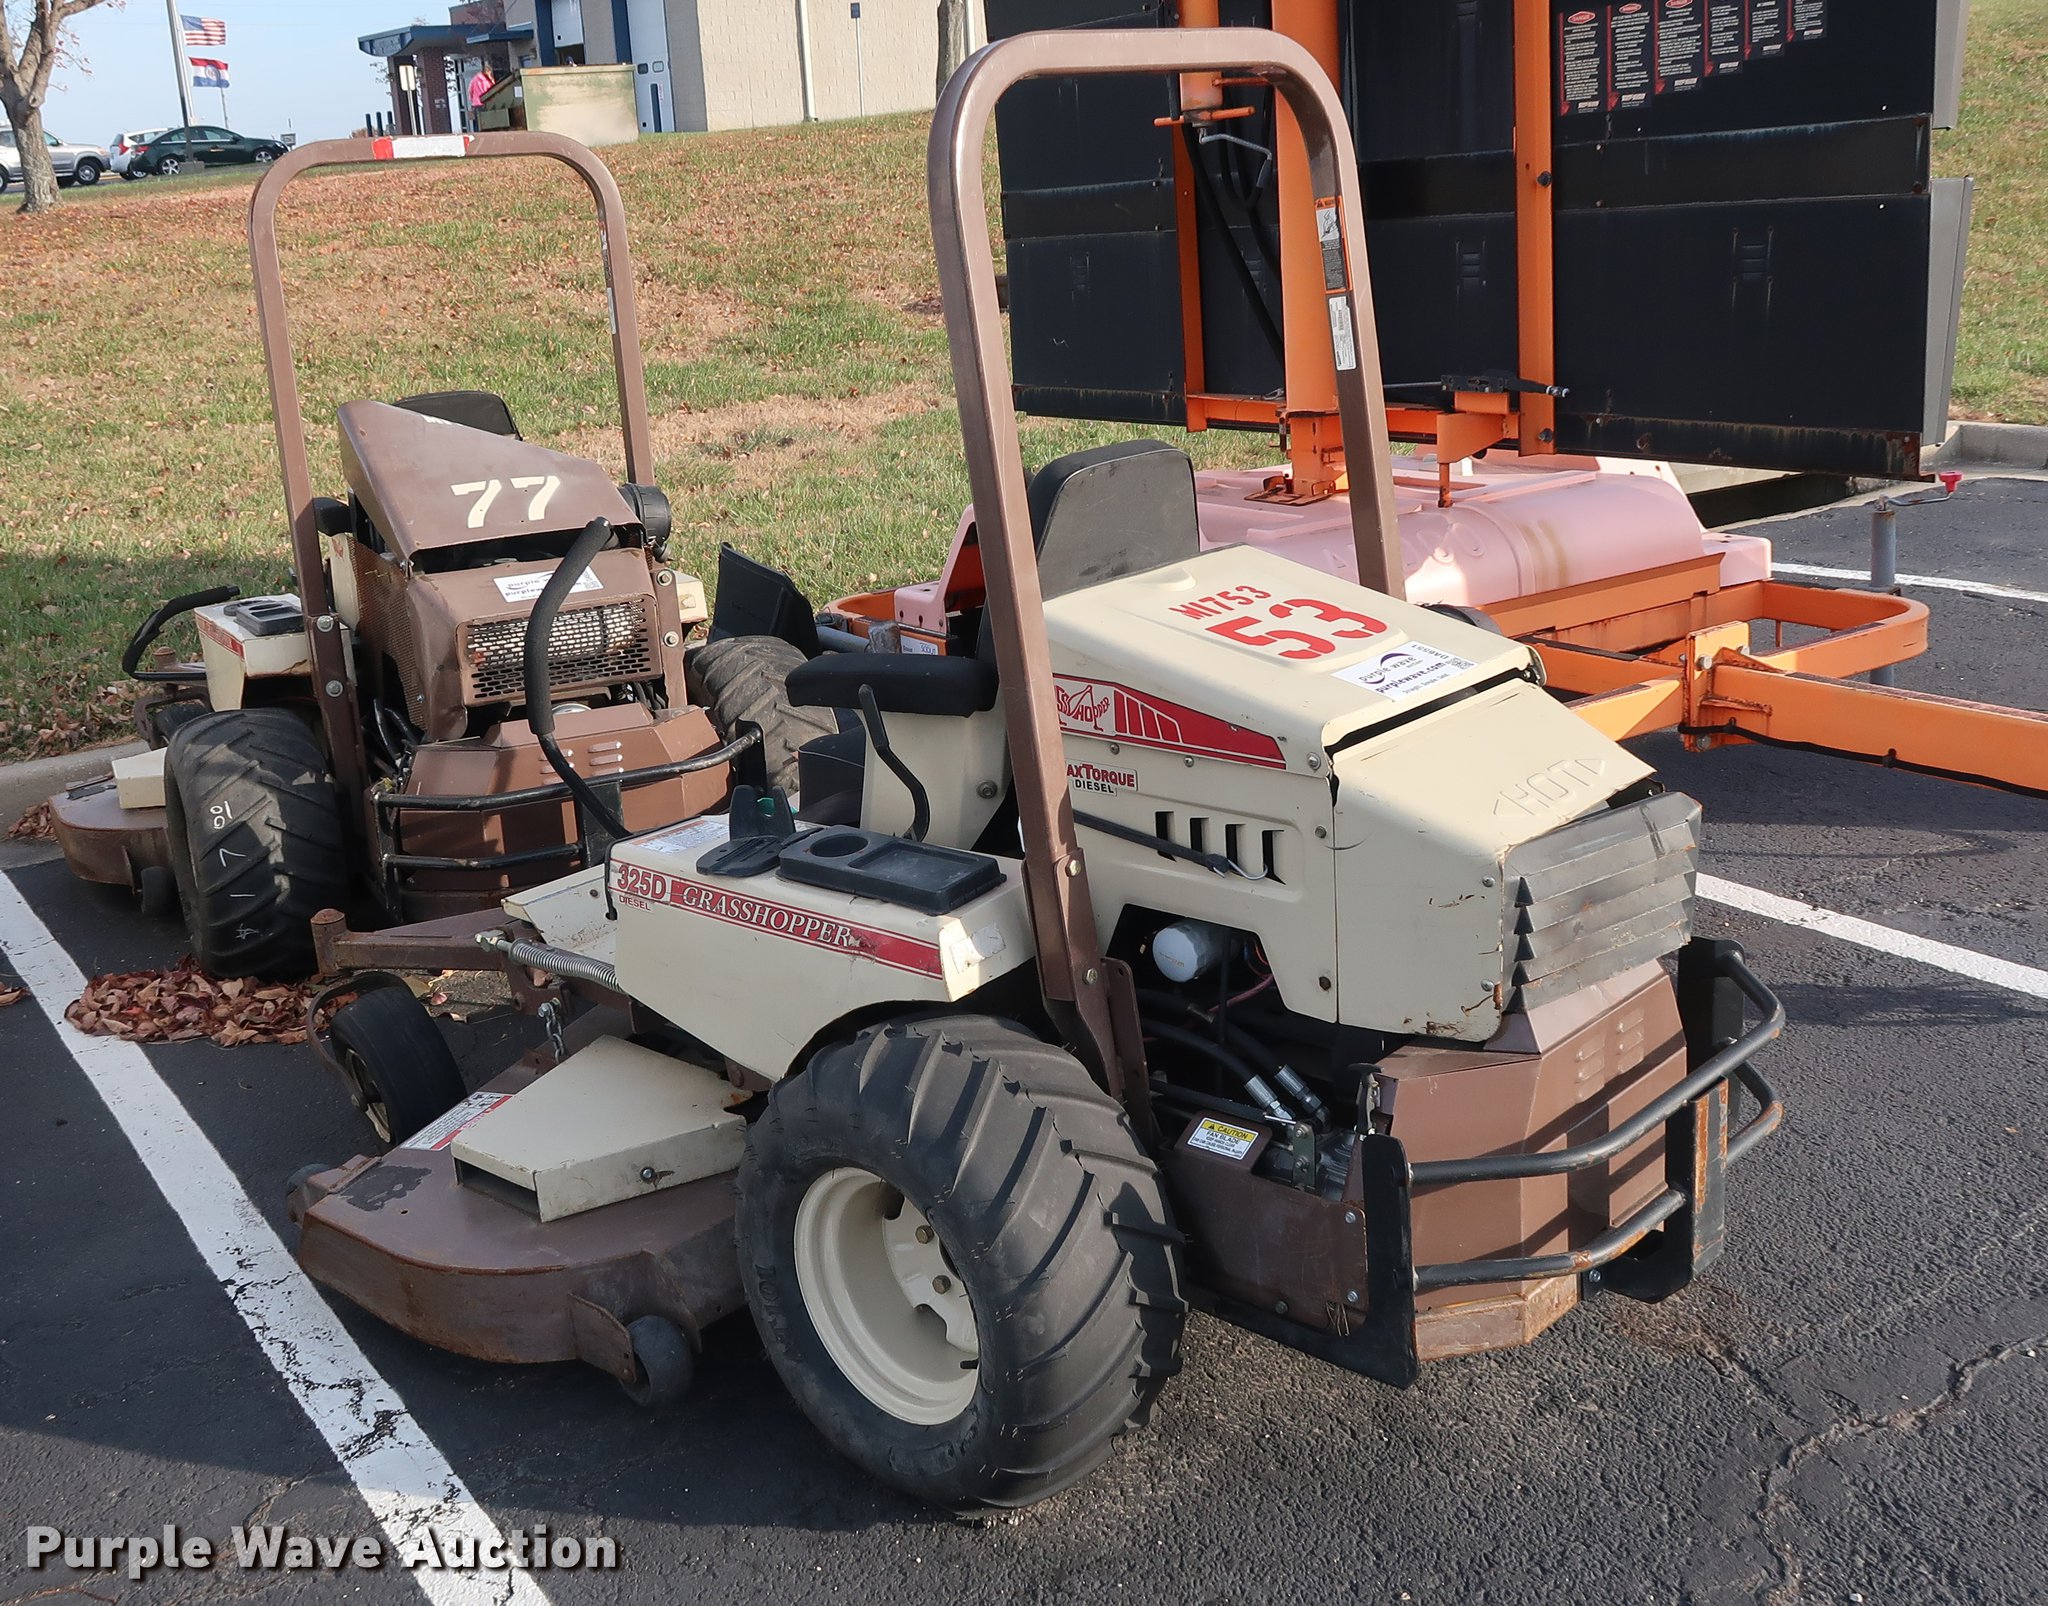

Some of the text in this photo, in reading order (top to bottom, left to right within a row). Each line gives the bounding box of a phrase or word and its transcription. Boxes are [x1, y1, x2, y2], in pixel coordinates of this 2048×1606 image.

[450, 475, 561, 529] 77
[1204, 598, 1388, 660] 53
[1358, 656, 1416, 682] purple wave
[1375, 661, 1447, 694] purplewave.com
[1066, 763, 1135, 788] AXTORQUE
[1075, 780, 1115, 794] DIESEL
[617, 863, 852, 948] 325D GRASSHOPPER
[618, 895, 652, 912] DIESEL
[1206, 1131, 1240, 1144] FAN BLADE
[1217, 1126, 1249, 1139] CAUTION
